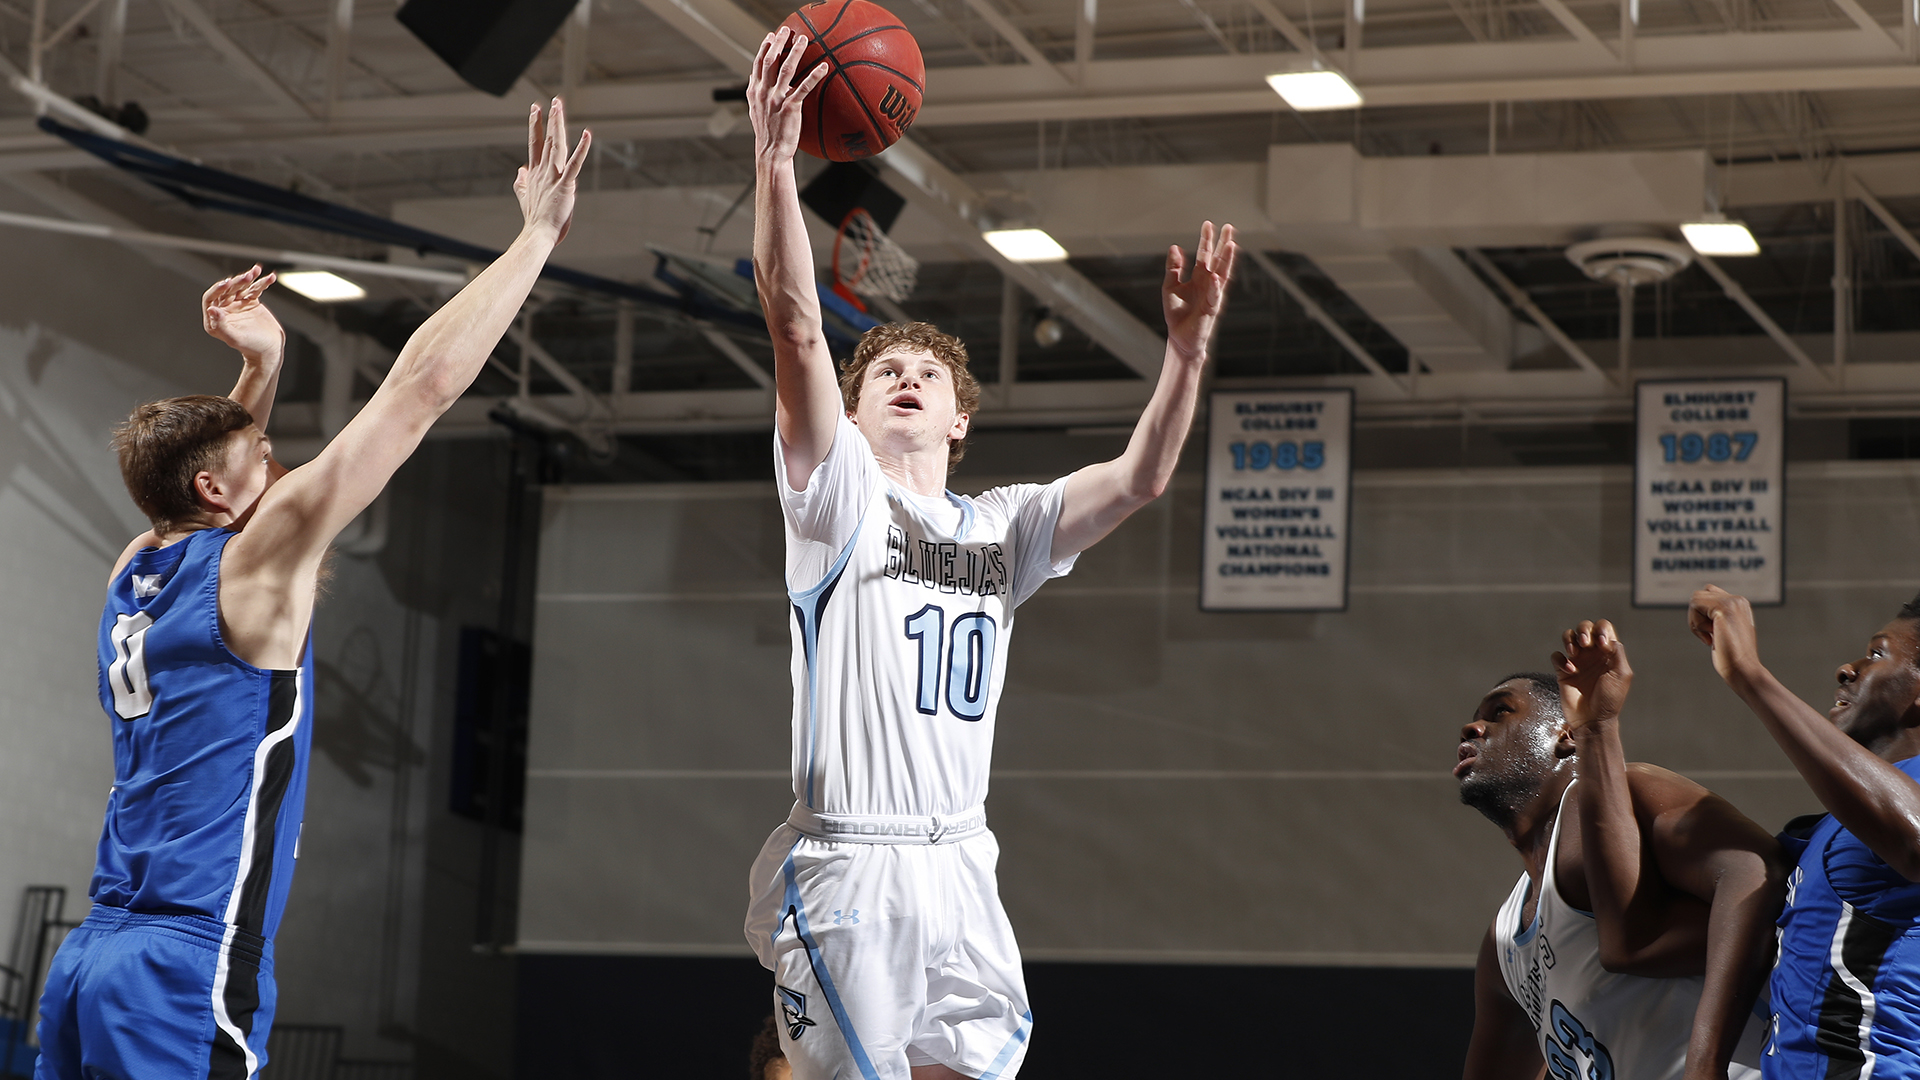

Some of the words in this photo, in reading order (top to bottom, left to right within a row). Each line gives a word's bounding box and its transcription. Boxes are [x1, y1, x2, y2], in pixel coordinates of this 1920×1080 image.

[879, 84, 917, 134] Wil
[841, 131, 873, 159] NC
[1664, 392, 1756, 406] ELMHURST
[1236, 402, 1324, 416] ELMHURST
[1671, 408, 1750, 422] COLLEGE
[1242, 418, 1318, 431] COLLEGE
[1659, 432, 1758, 463] 1987
[1230, 441, 1325, 471] 1985
[1221, 488, 1273, 501] NCAA
[1279, 488, 1310, 500] DIV
[1315, 487, 1335, 500] III
[1651, 481, 1705, 495] NCAA
[1711, 480, 1744, 494] DIV
[1750, 479, 1768, 493] III
[1232, 506, 1321, 519] WOMEN'S
[1664, 499, 1755, 513] WOMEN'S
[1216, 525, 1336, 539] VOLLEYBALL
[1647, 518, 1771, 533] VOLLEYBALL
[1227, 544, 1322, 558] NATIONAL
[1659, 538, 1757, 552] NATIONAL
[884, 524, 1007, 596] BLUEJAS
[1652, 557, 1765, 572] RUNNER-UP
[1219, 563, 1330, 577] CHAMPIONS
[108, 610, 154, 722] 0
[904, 603, 997, 722] 10
[945, 813, 986, 836] NDER
